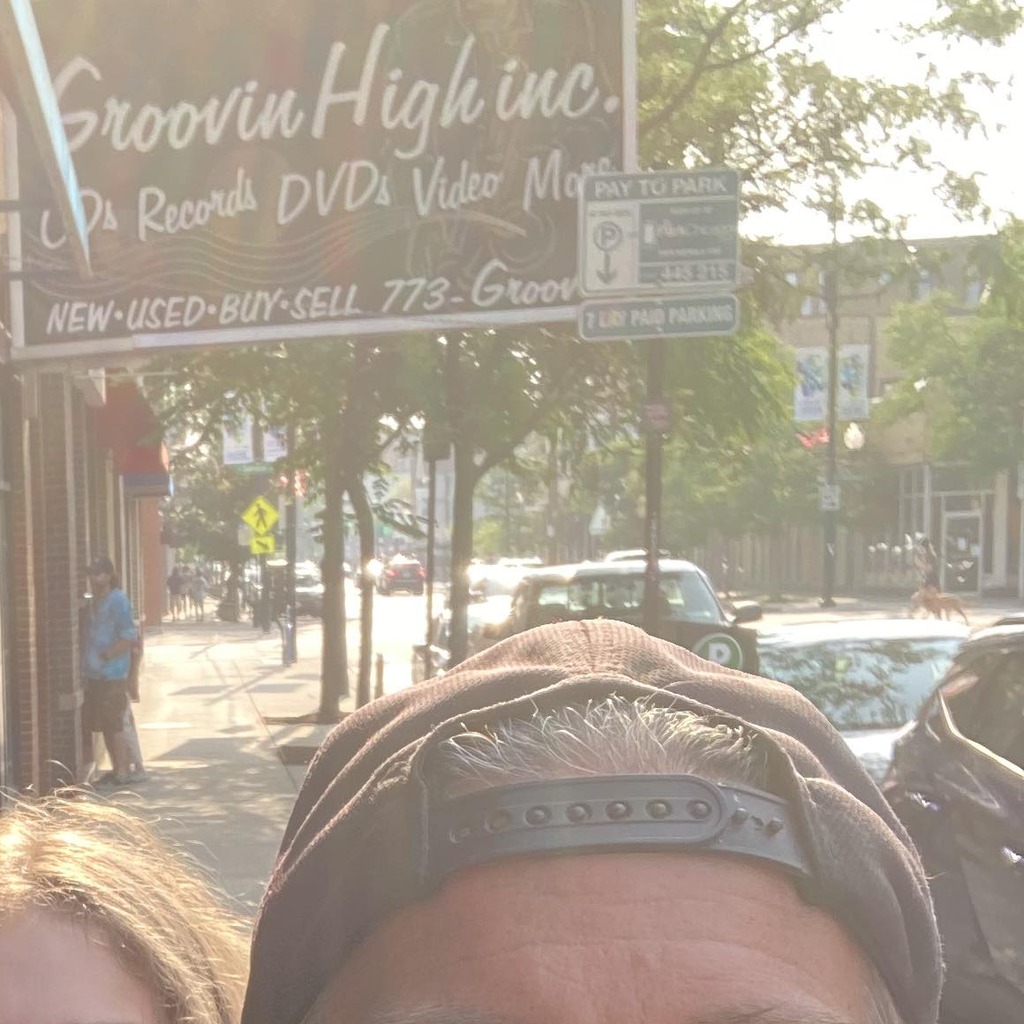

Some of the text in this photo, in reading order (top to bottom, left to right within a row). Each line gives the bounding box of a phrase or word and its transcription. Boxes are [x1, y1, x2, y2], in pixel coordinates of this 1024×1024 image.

[50, 22, 621, 161] Groovin High inc.
[137, 166, 257, 242] Records
[277, 169, 392, 227] DVDs
[412, 165, 504, 227] Video
[594, 176, 728, 199] PAY TO PARK
[630, 307, 666, 327] PAID
[669, 303, 734, 325] PARKING
